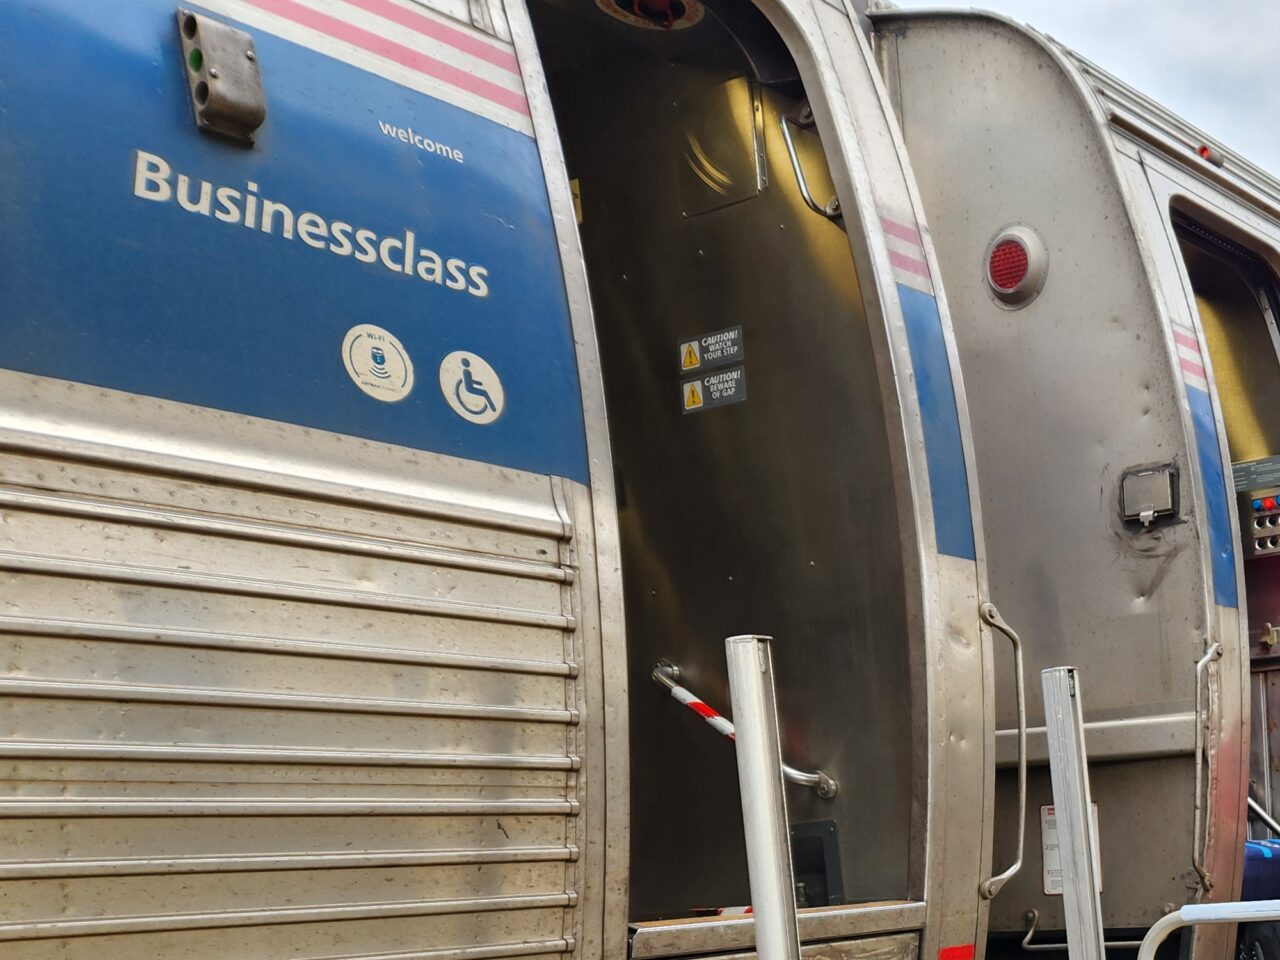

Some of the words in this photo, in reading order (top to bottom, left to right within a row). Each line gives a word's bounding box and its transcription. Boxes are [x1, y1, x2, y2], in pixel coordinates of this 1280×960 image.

[378, 119, 465, 163] welcome
[133, 149, 490, 298] Businessclass
[701, 329, 738, 347] CAUTION!
[708, 339, 732, 351] WATCH
[703, 350, 721, 361] YOUR
[723, 345, 738, 356] STEP
[704, 369, 741, 386] CAUTION!
[709, 379, 736, 393] BEWARE
[711, 390, 721, 399] OF
[722, 387, 736, 397] GAP
